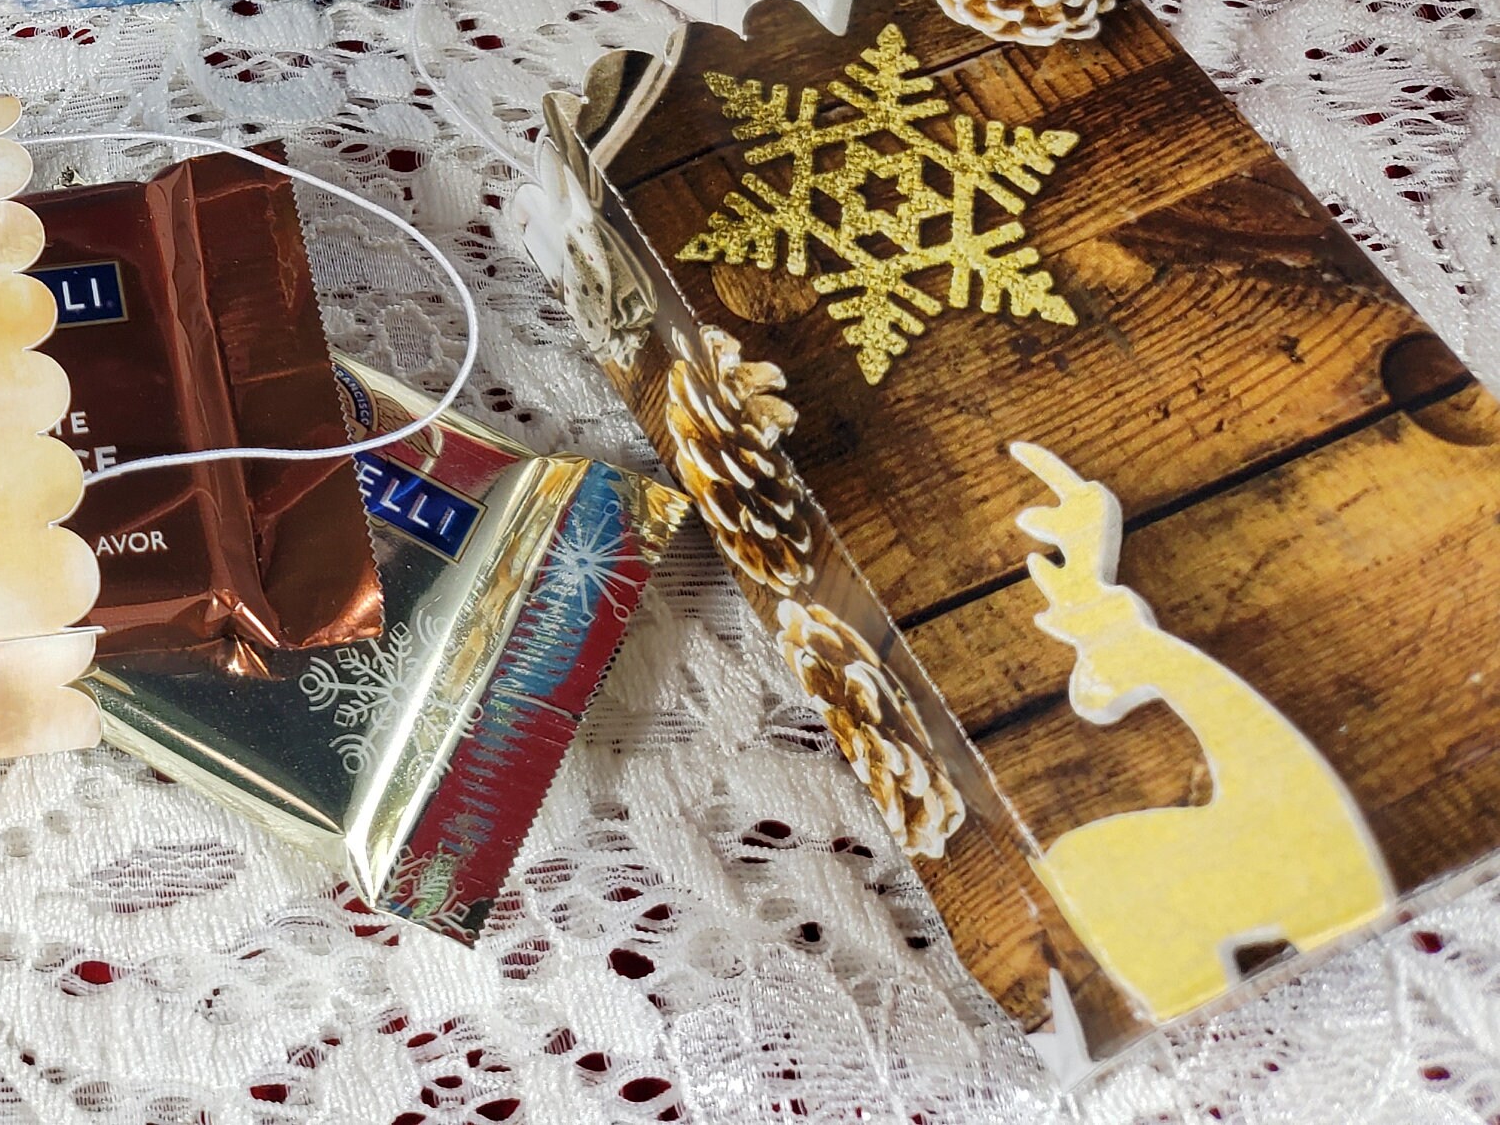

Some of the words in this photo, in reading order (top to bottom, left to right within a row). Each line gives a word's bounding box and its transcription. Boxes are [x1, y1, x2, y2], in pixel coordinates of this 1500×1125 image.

[62, 277, 102, 311] LI
[356, 460, 456, 536] ELLI
[96, 530, 168, 557] AVOR
